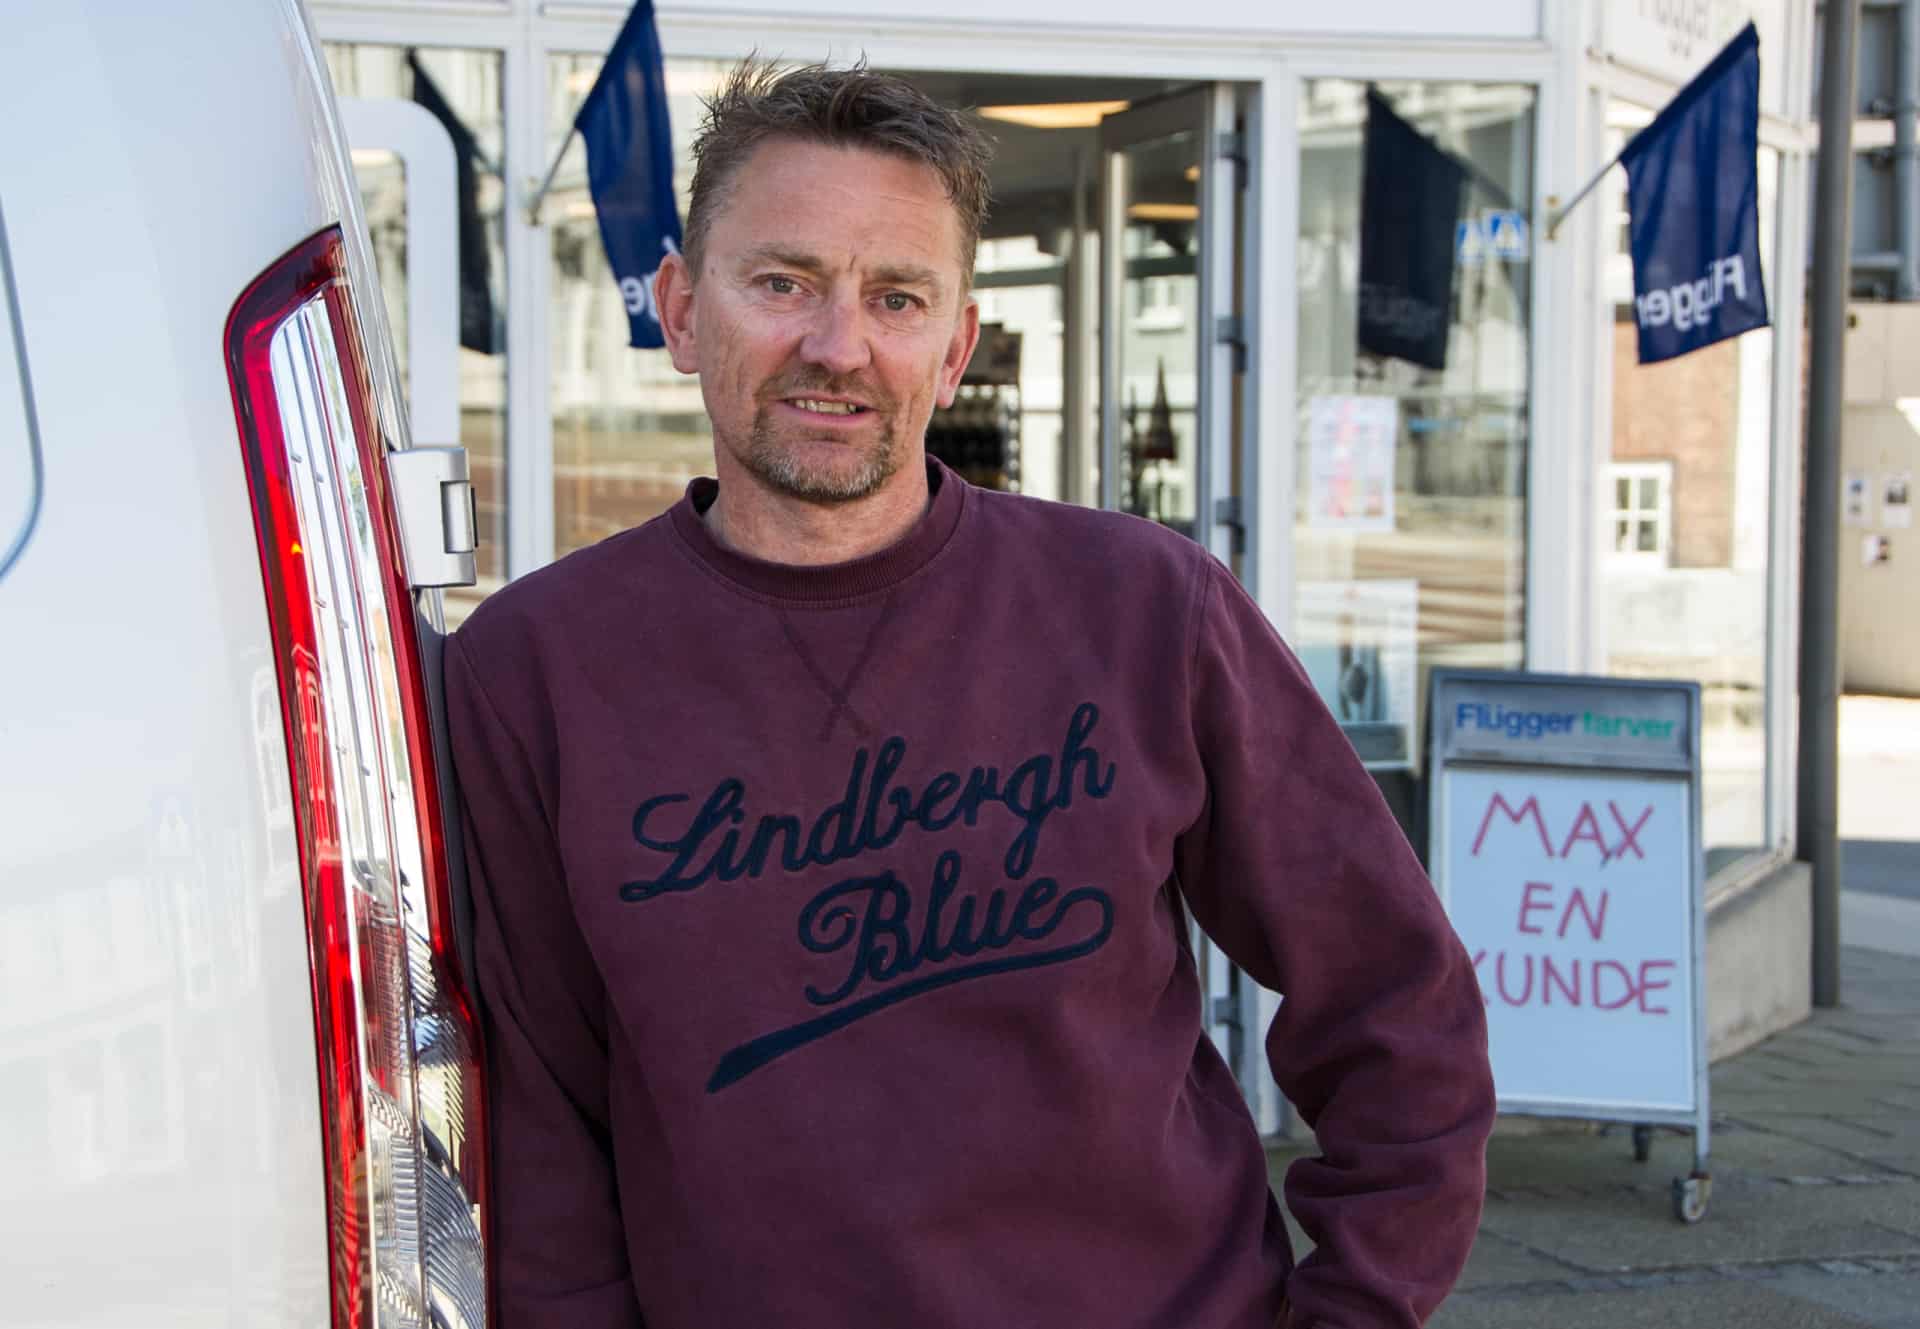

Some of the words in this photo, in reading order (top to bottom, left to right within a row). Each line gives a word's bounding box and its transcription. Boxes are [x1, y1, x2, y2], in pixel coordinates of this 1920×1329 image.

[1456, 702, 1575, 739] Flügger
[1583, 709, 1675, 739] farver
[619, 701, 1116, 902] Lindbergh
[1471, 791, 1654, 859] MAX
[799, 851, 1114, 1005] Blue
[1517, 880, 1609, 941] EN
